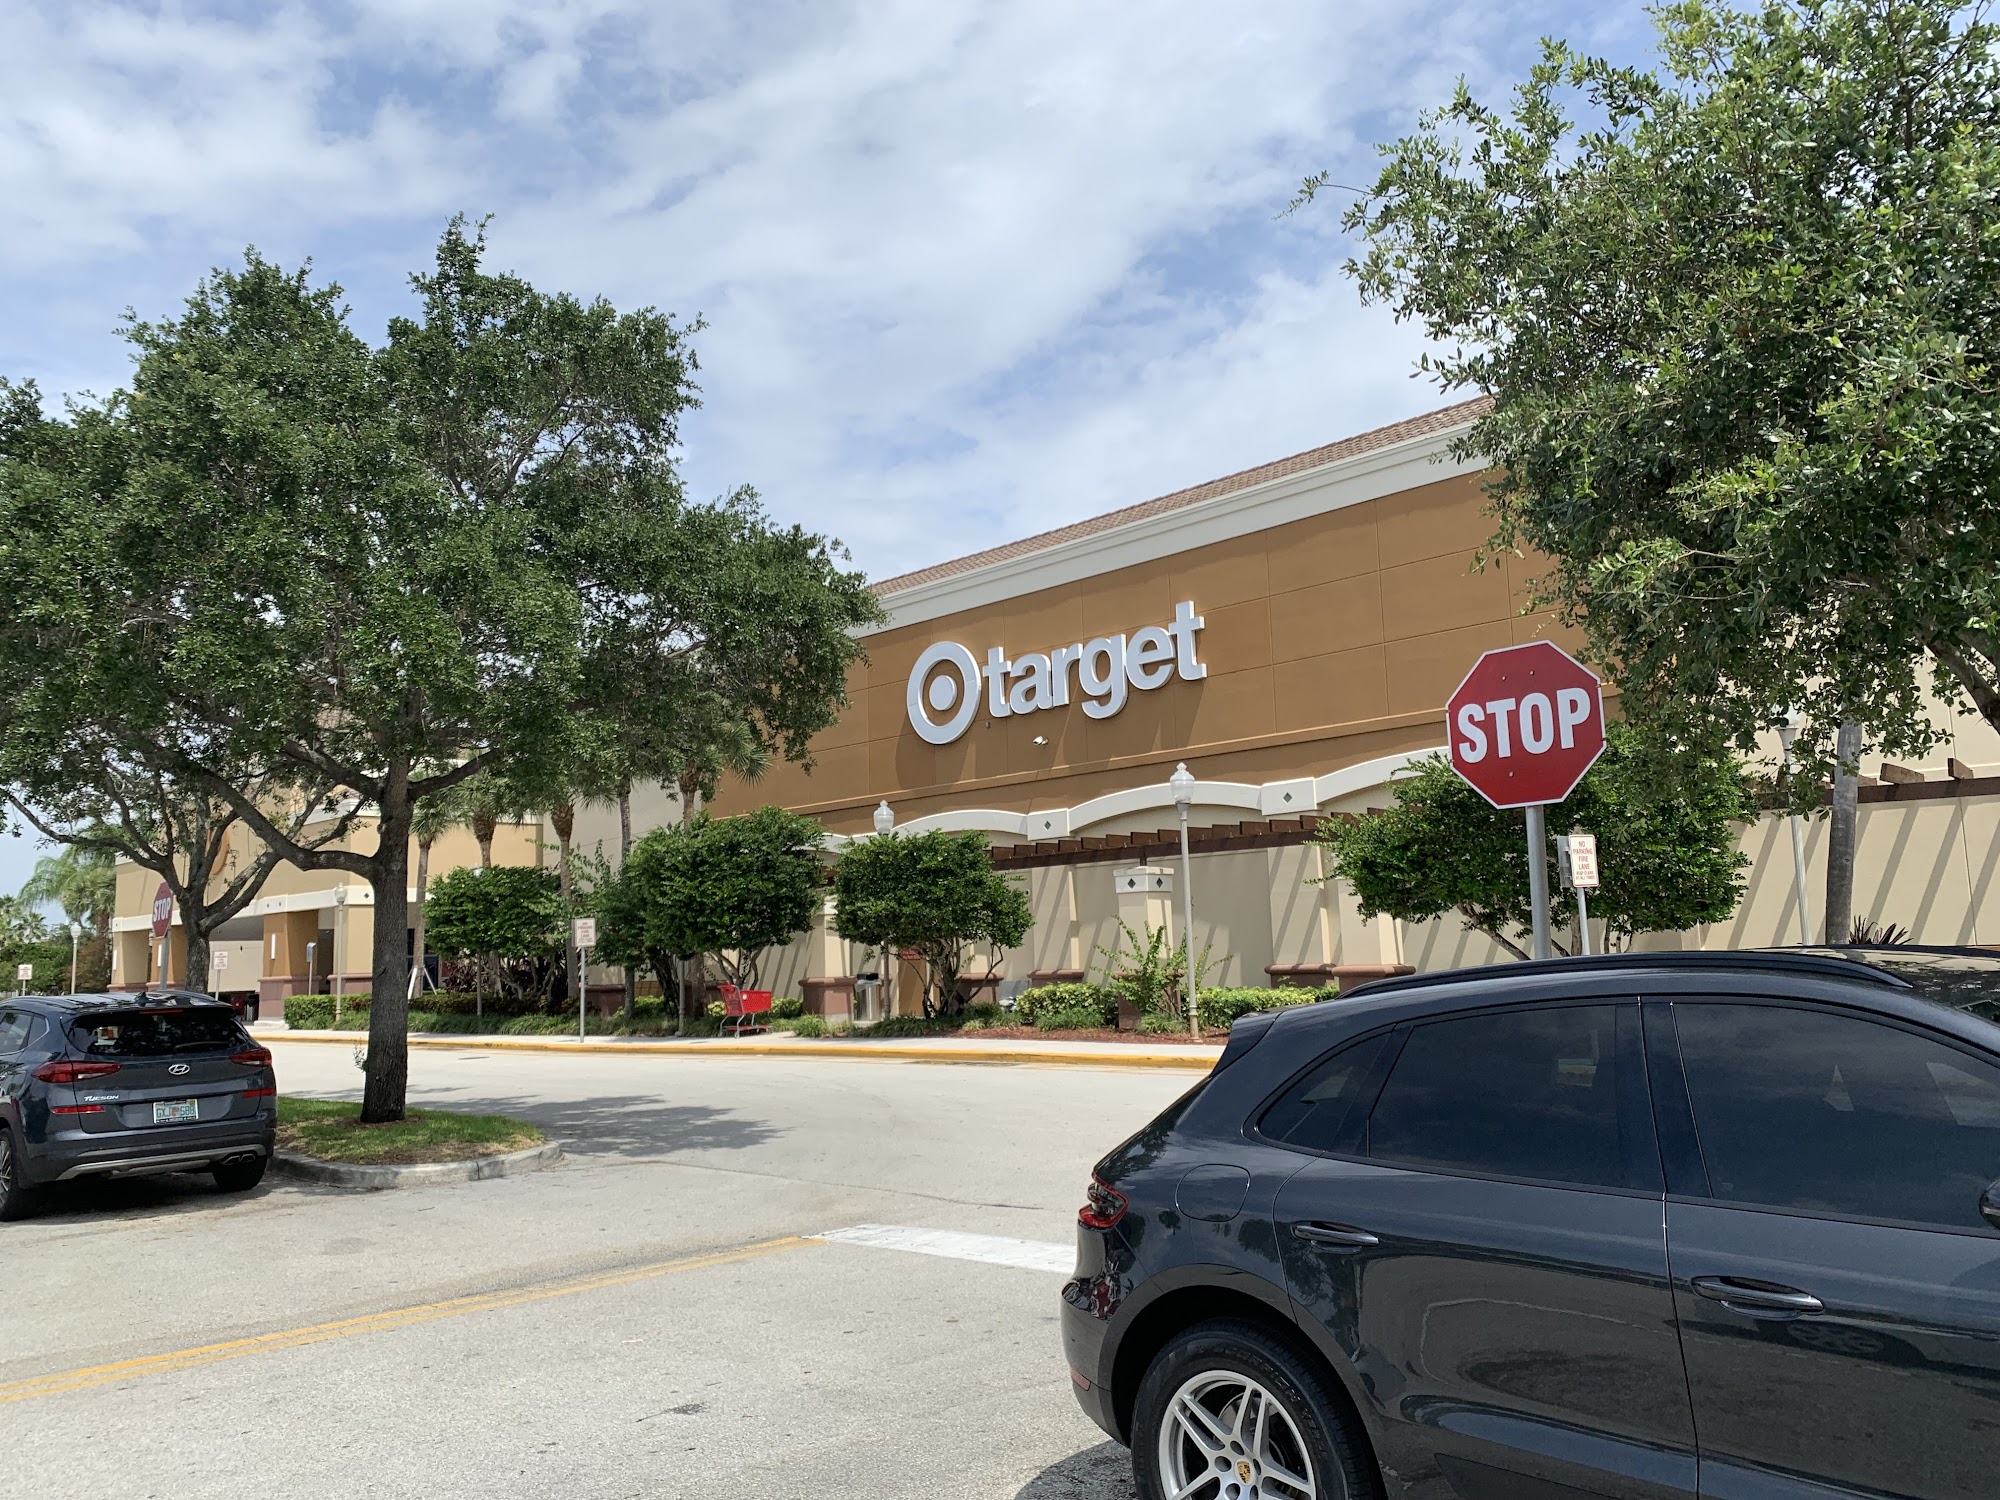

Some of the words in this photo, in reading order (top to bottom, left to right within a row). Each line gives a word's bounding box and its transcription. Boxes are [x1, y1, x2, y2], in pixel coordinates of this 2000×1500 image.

[982, 600, 1208, 720] target
[1457, 687, 1591, 764] STOP
[1572, 847, 1594, 855] PARKING
[1578, 855, 1589, 863] FIRE
[153, 897, 171, 922] STOP
